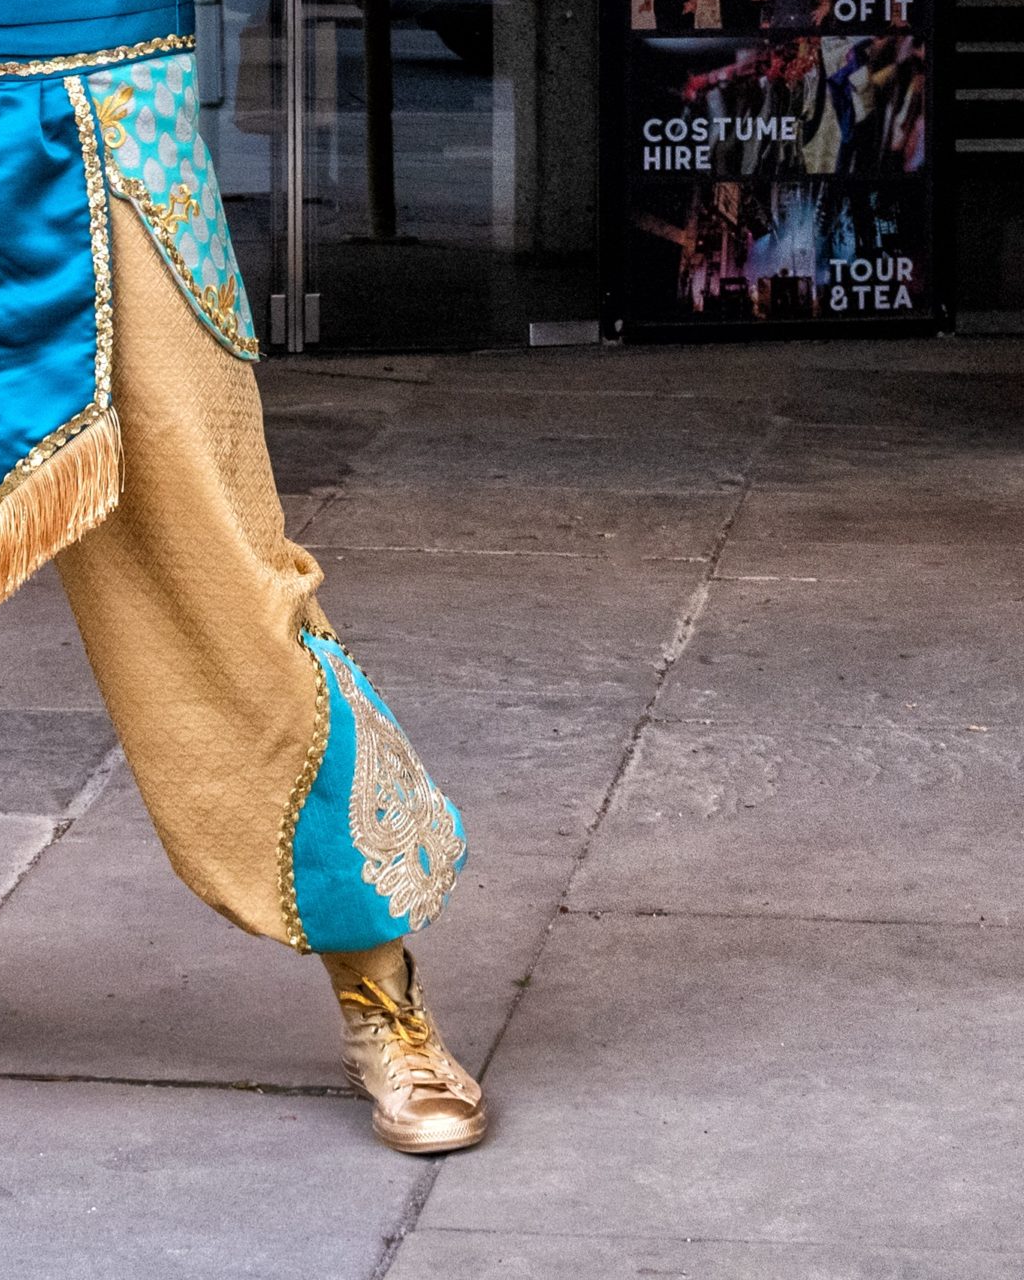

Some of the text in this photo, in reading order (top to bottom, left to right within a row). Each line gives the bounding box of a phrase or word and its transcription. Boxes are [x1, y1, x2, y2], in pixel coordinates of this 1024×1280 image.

[643, 116, 797, 143] COSTUME
[643, 145, 712, 170] HIRE
[829, 257, 914, 283] TOUR
[829, 285, 913, 311] &TEA
